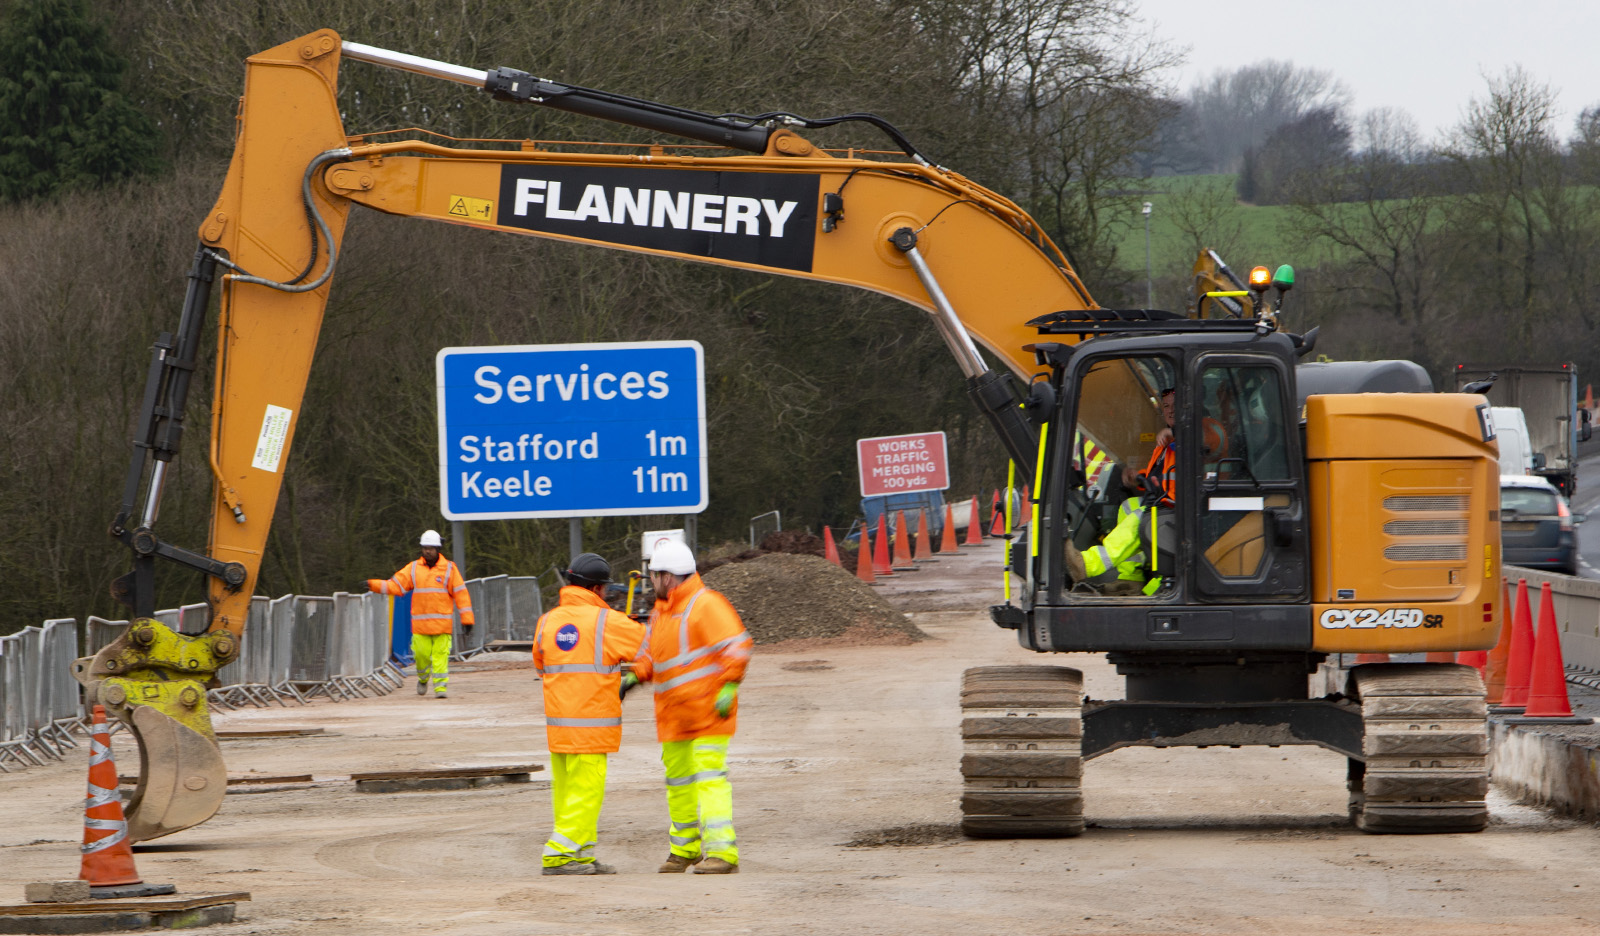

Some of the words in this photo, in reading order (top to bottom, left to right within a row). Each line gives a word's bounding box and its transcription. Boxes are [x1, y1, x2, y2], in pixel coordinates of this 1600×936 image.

[514, 178, 798, 238] FLANNERY
[473, 363, 670, 405] Services
[459, 431, 598, 463] Stafford
[645, 429, 687, 457] 1m
[878, 439, 926, 453] WORKS
[876, 450, 929, 464] TRAFFIC
[873, 462, 935, 477] MERGING
[461, 470, 552, 498] Keele
[632, 466, 689, 493] 11m
[906, 475, 927, 488] yds
[1320, 608, 1424, 629] CX245D
[1423, 614, 1443, 628] SR
